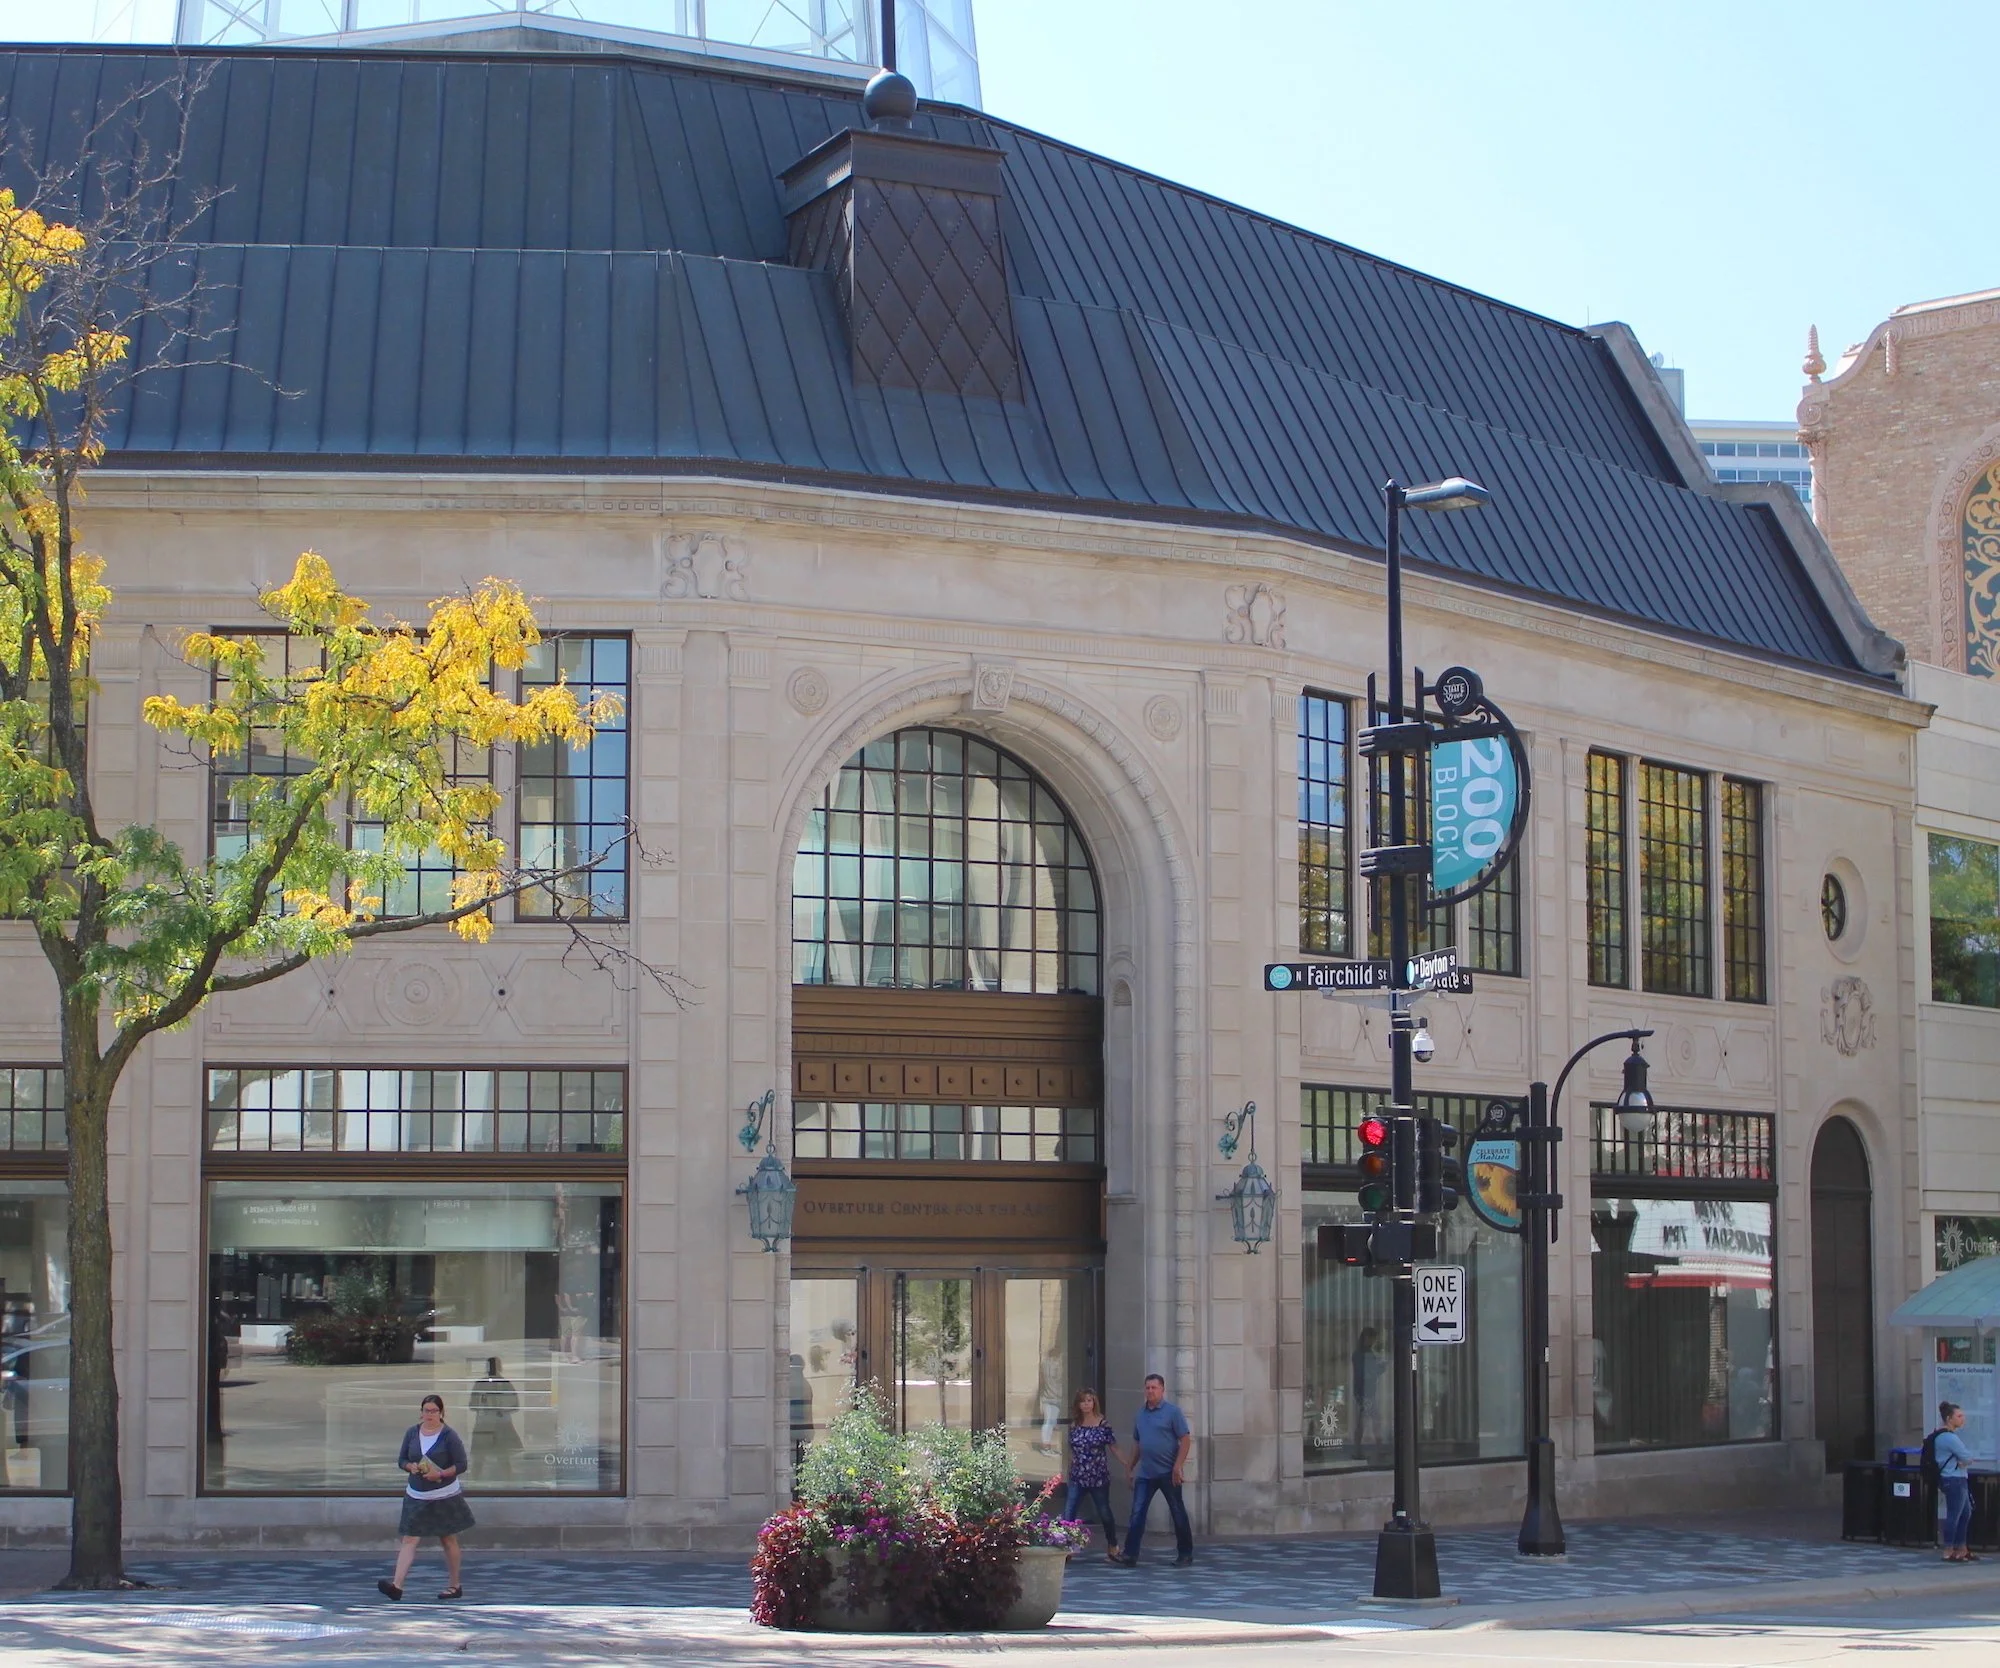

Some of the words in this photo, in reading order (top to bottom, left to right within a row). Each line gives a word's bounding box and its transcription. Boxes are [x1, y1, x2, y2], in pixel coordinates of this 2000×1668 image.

[1443, 683, 1465, 695] STATE
[1461, 738, 1504, 859] 200
[1435, 766, 1459, 864] BLOCK
[1420, 954, 1448, 979] Dayton
[1449, 954, 1456, 966] St
[1296, 970, 1302, 982] N
[1307, 965, 1373, 986] Fairchild
[1377, 969, 1388, 981] St
[1433, 971, 1460, 989] tate
[1463, 974, 1470, 985] St
[1476, 1152, 1510, 1161] Madison
[1423, 1275, 1457, 1292] ONE
[1422, 1296, 1457, 1313] WAY
[1314, 1436, 1344, 1447] Overture
[544, 1453, 599, 1465] Overture
